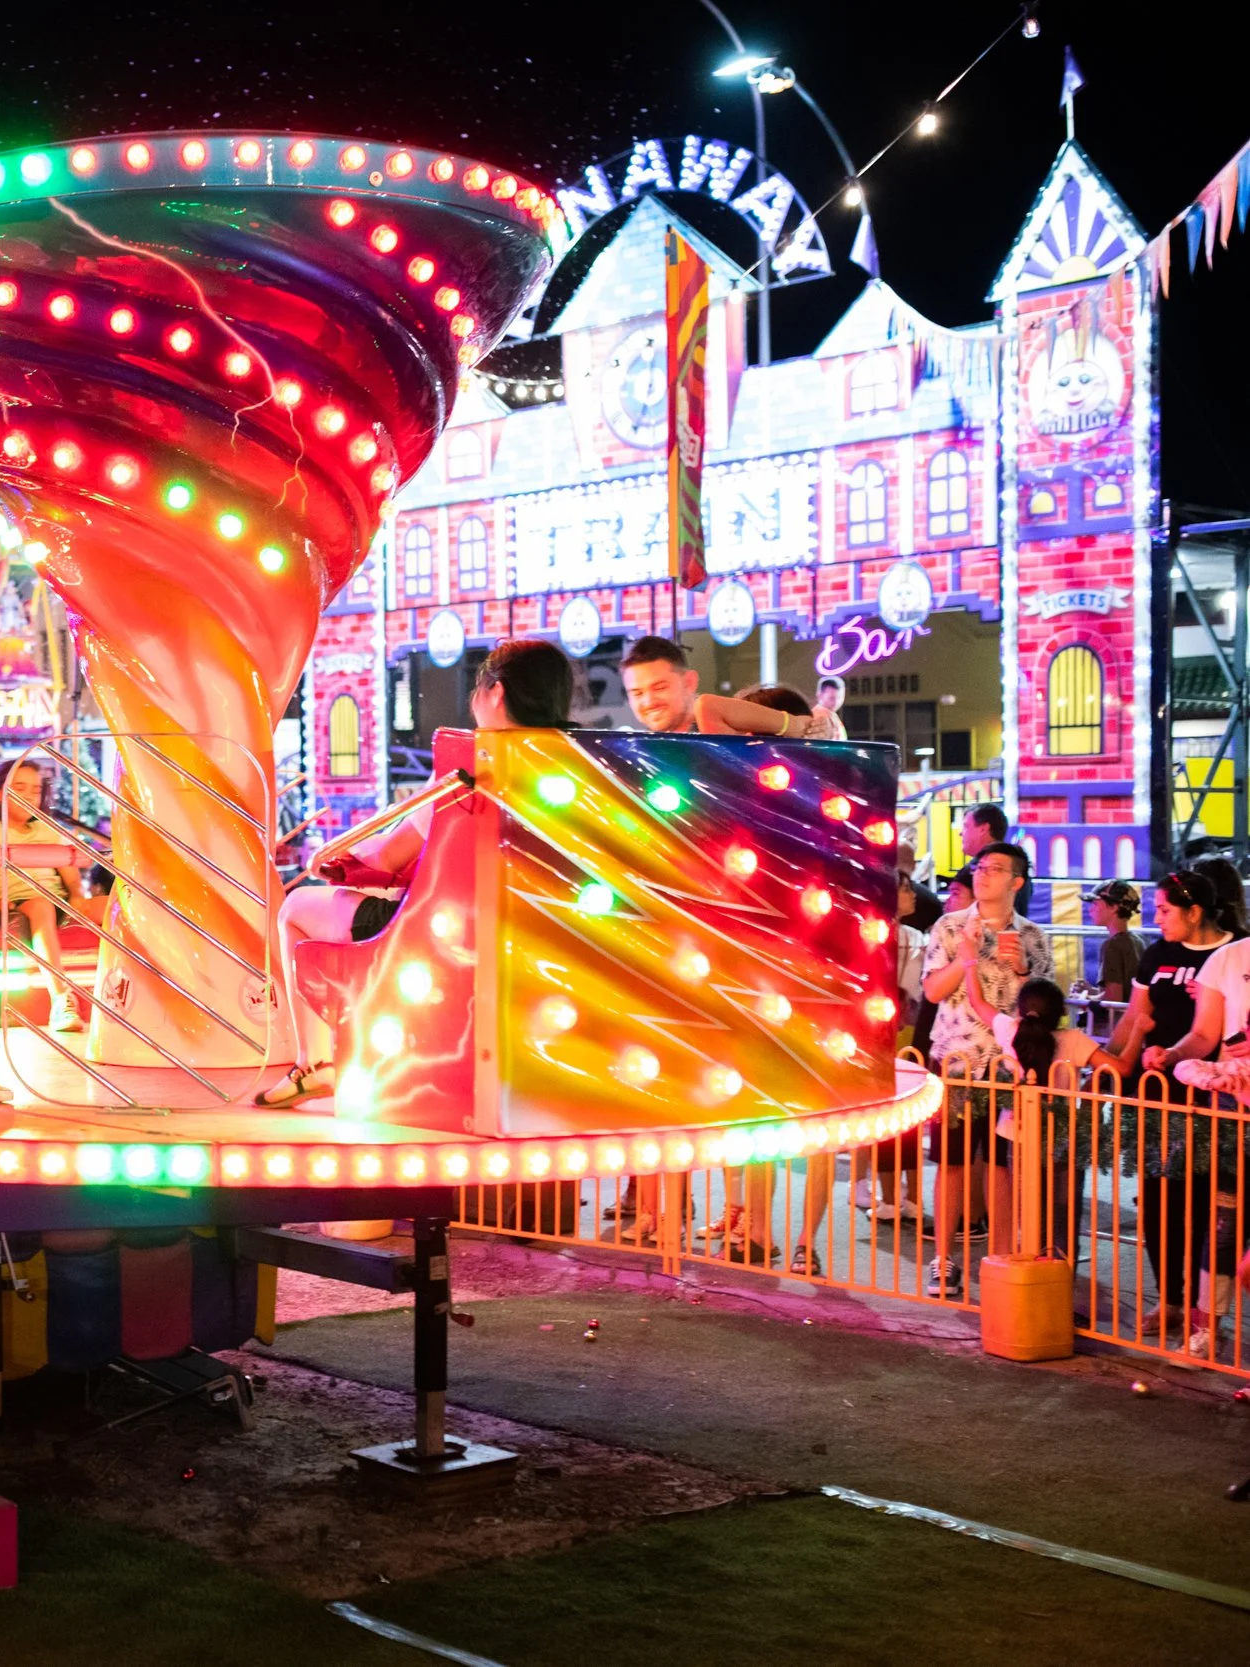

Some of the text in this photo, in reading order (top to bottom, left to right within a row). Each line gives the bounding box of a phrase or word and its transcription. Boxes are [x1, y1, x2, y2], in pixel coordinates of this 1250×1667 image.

[505, 134, 833, 342] NAWAY
[1043, 593, 1106, 611] TICKETS
[1150, 966, 1197, 986] FIL
